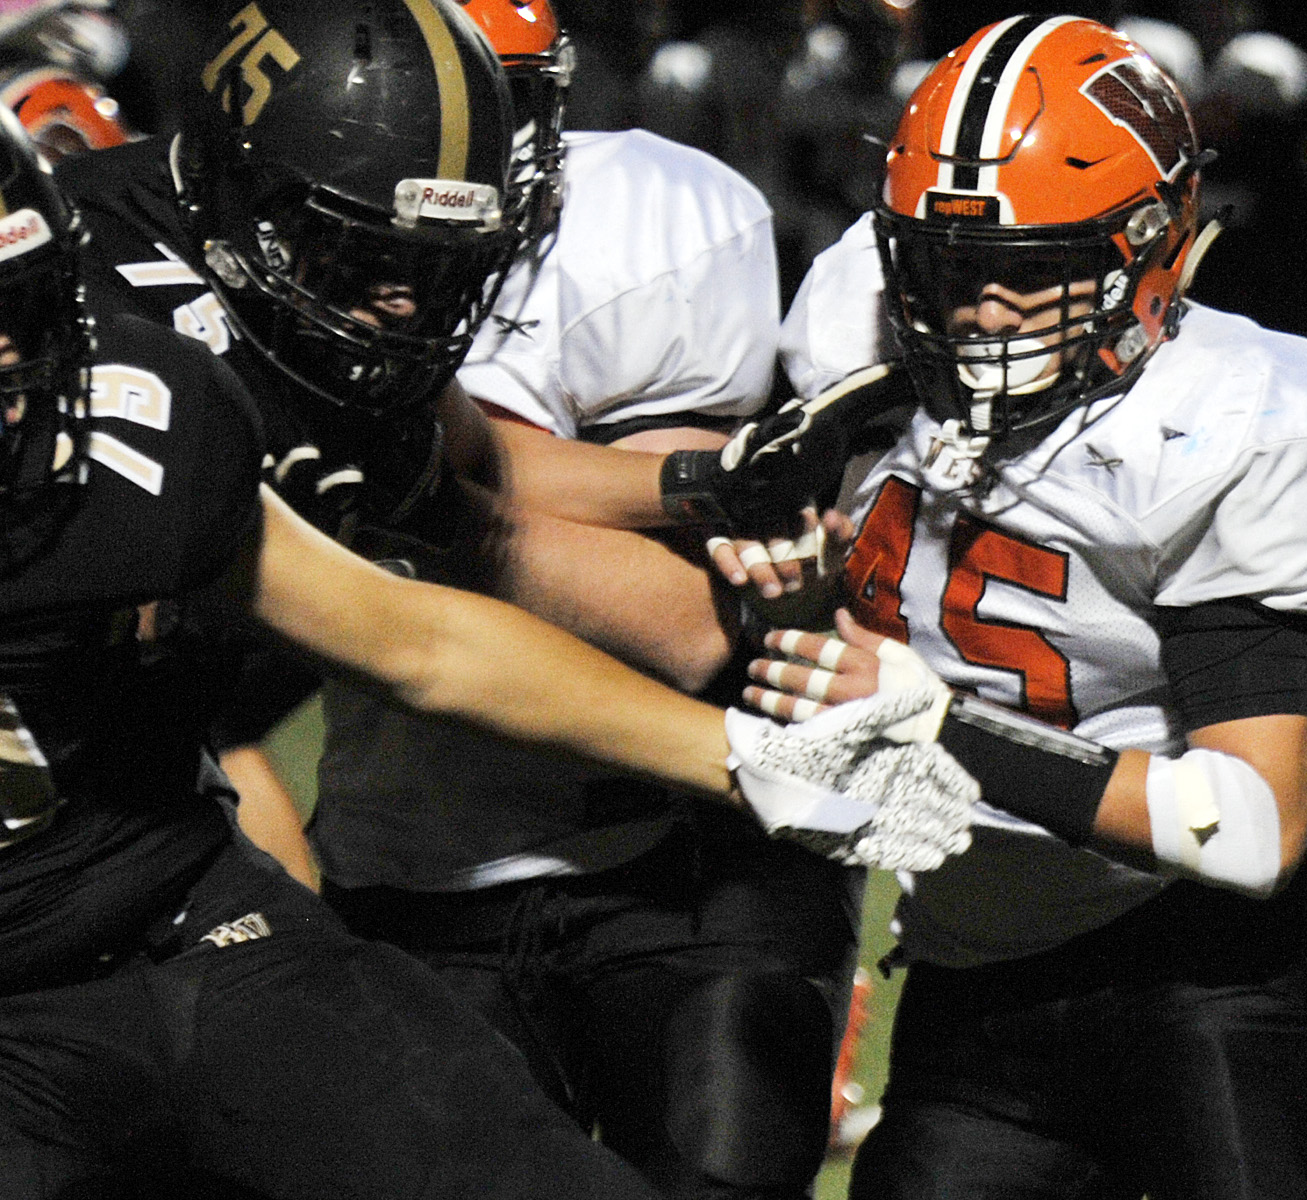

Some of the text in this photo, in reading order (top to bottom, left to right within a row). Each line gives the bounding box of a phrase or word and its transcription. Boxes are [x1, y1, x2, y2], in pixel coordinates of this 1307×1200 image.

[201, 1, 301, 126] 75
[423, 187, 475, 208] Riddell
[845, 473, 1078, 735] 45
